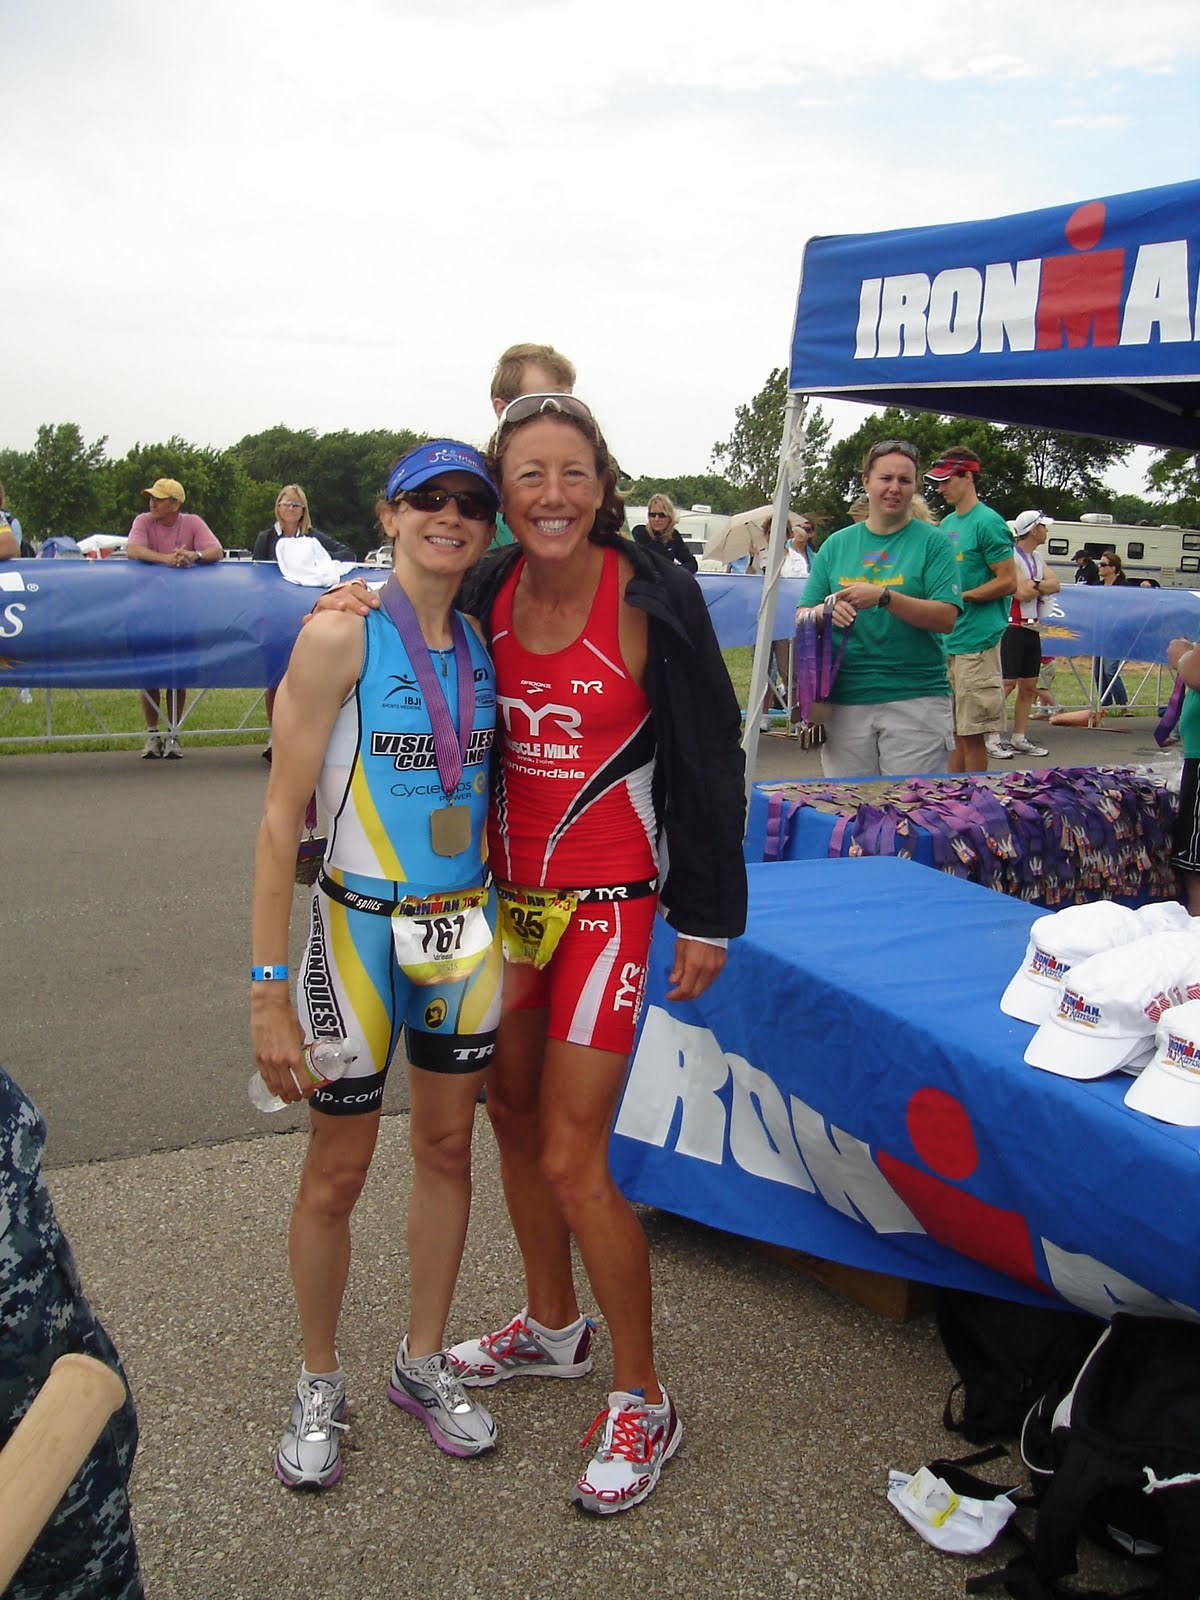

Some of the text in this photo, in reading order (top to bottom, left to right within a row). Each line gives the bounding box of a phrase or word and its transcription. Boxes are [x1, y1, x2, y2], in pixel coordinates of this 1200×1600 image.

[853, 200, 1200, 360] IRONMA
[520, 680, 552, 689] BROOKS
[570, 680, 603, 694] TYR
[404, 696, 422, 706] IBJI
[496, 695, 584, 739] TYR
[396, 749, 485, 770] COAING
[543, 743, 581, 759] MILK
[390, 782, 471, 797] Cycleps
[595, 886, 628, 900] TYR
[399, 896, 460, 915] IONMAN
[509, 907, 545, 940] 35
[578, 919, 609, 933] TYR
[413, 915, 465, 953] 761
[613, 962, 641, 1011] TYR
[1062, 992, 1100, 1017] IRONMAN
[1069, 1009, 1099, 1024] Kansas
